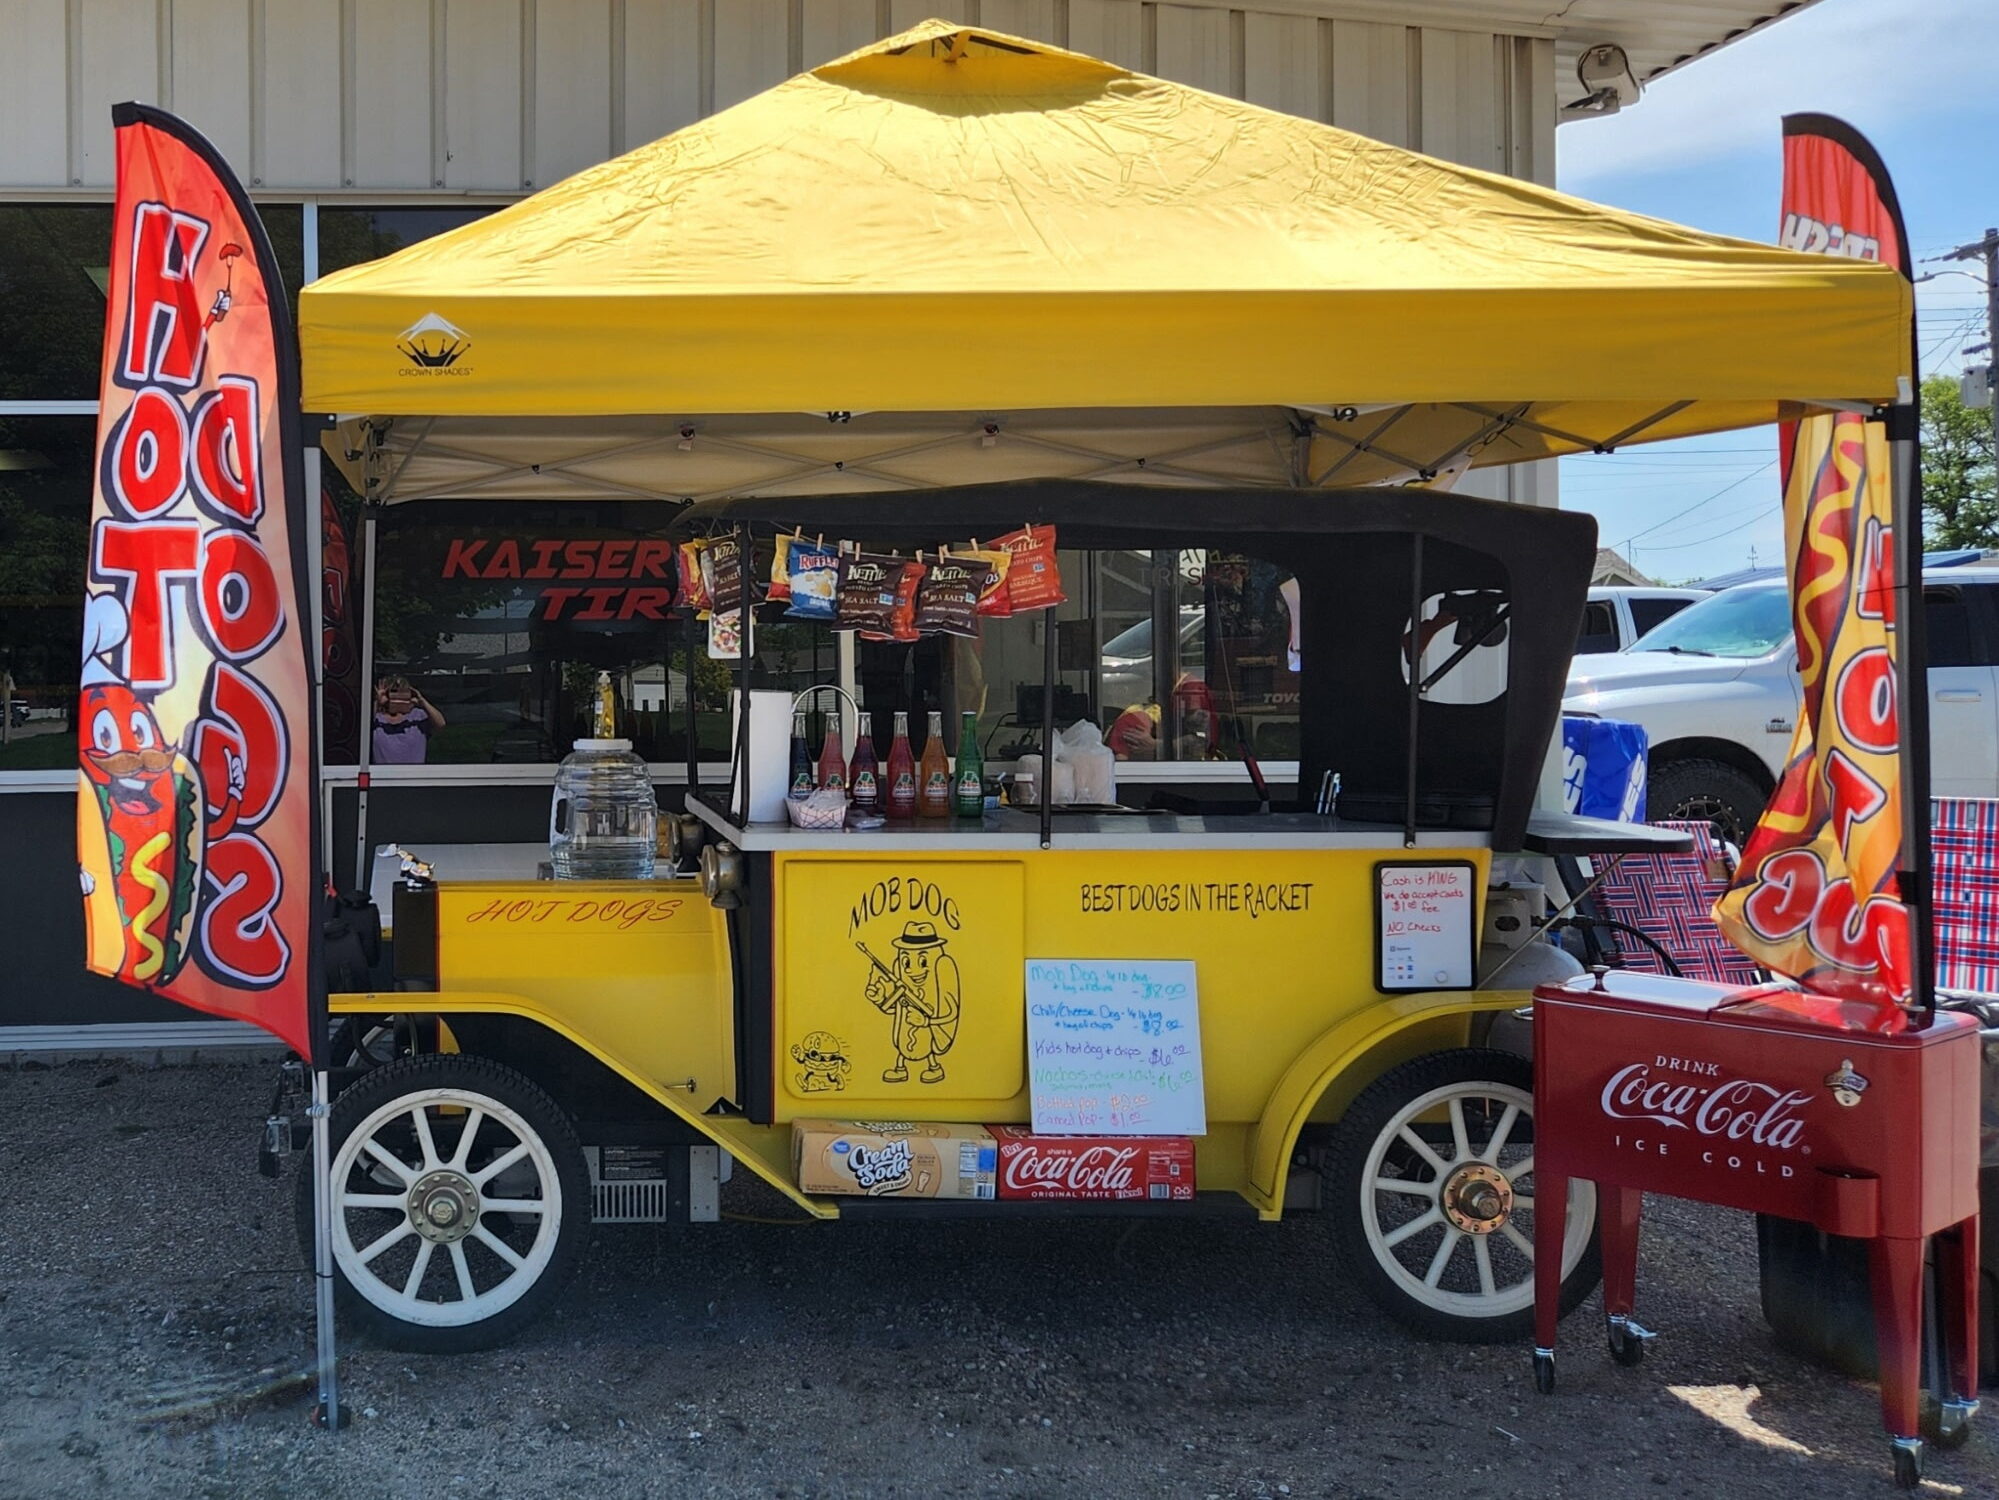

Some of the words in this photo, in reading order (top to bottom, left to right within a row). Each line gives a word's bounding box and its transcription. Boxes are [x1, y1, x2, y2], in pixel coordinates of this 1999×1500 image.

[398, 368, 432, 377] CROWN
[434, 367, 471, 377] SHADES
[441, 539, 673, 579] KAISER
[540, 586, 686, 620] TIR
[1382, 871, 1411, 887] Cash
[466, 899, 570, 922] HOT
[566, 899, 684, 930] DOGS
[848, 876, 900, 939] MOB
[907, 877, 961, 931] DOG
[1081, 884, 1126, 912] BEST
[1128, 884, 1181, 912] DOGS
[1185, 883, 1202, 912] IN
[1204, 883, 1241, 911] THE
[1243, 882, 1314, 919] RACKET
[1656, 1055, 1720, 1076] DRINK
[1600, 1063, 1815, 1149] Coca-Cola
[849, 1138, 915, 1171] Cream
[856, 1152, 911, 1187] Soda
[1005, 1146, 1142, 1189] Coca-Cola
[1615, 1135, 1668, 1155] ICE
[1703, 1152, 1794, 1177] COLD
[1031, 1190, 1078, 1199] ORIGINAL
[1081, 1190, 1111, 1199] TASTE
